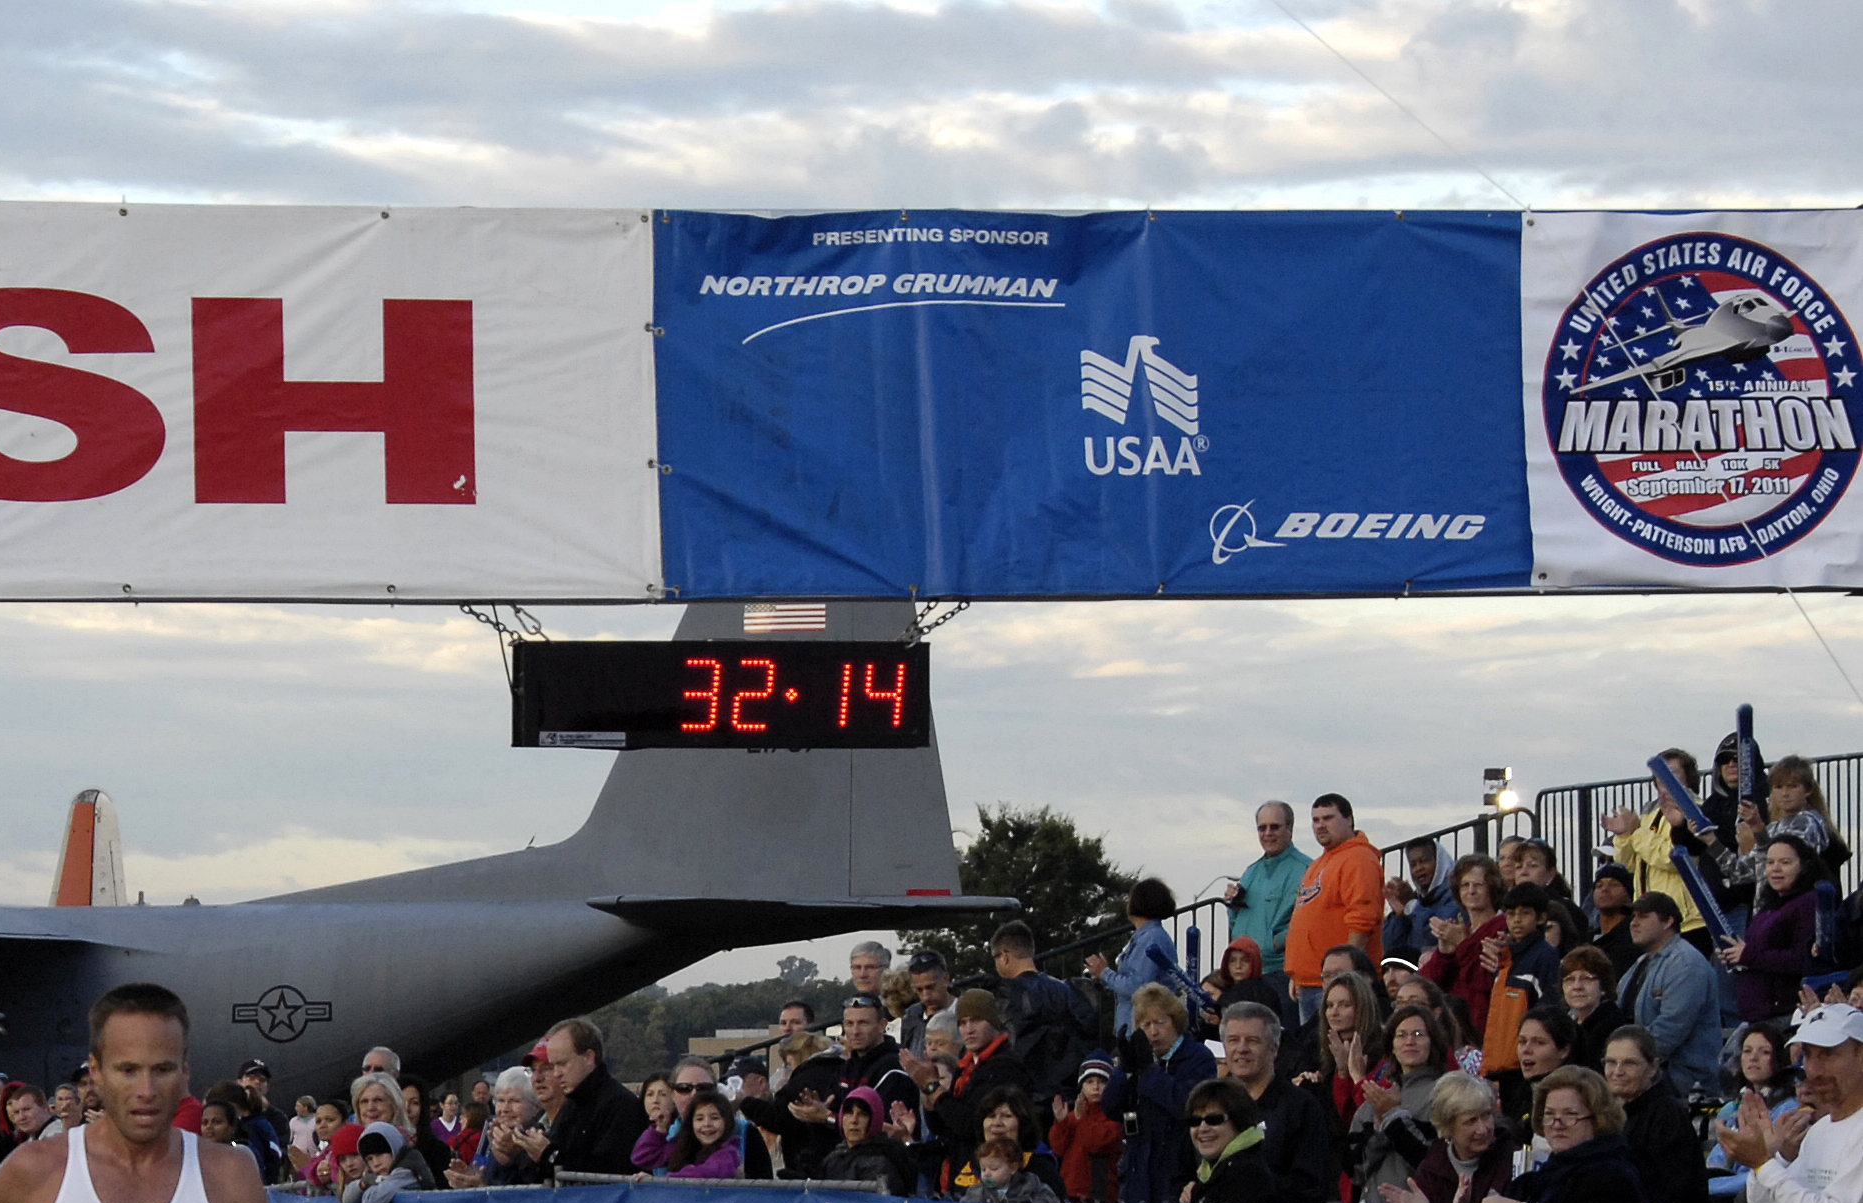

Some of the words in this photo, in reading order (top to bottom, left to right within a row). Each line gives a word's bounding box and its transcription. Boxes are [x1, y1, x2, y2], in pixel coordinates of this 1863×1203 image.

[812, 227, 944, 246] PRESENTING
[949, 228, 1049, 246] SPONSOR
[699, 273, 887, 297] NORTHROP
[892, 273, 1058, 298] GRUMMAN
[1569, 263, 1638, 333] UNITED
[1642, 241, 1721, 276] STATES
[1726, 246, 1768, 279] AIR
[1768, 266, 1836, 333] FORCE
[1743, 379, 1810, 391] ANNUAL
[1556, 398, 1858, 453] MARATHON
[1631, 460, 1663, 472] FULL
[1722, 460, 1748, 471] 10K
[1763, 460, 1780, 471] 5K
[1626, 477, 1728, 497] September
[1728, 477, 1749, 495] 17,
[1751, 477, 1792, 495] 2011
[1579, 474, 1716, 555] WRIGHT-PATTERSON
[1719, 535, 1748, 555] AFB
[1811, 467, 1841, 503] OHIO
[1274, 512, 1486, 540] BOEING
